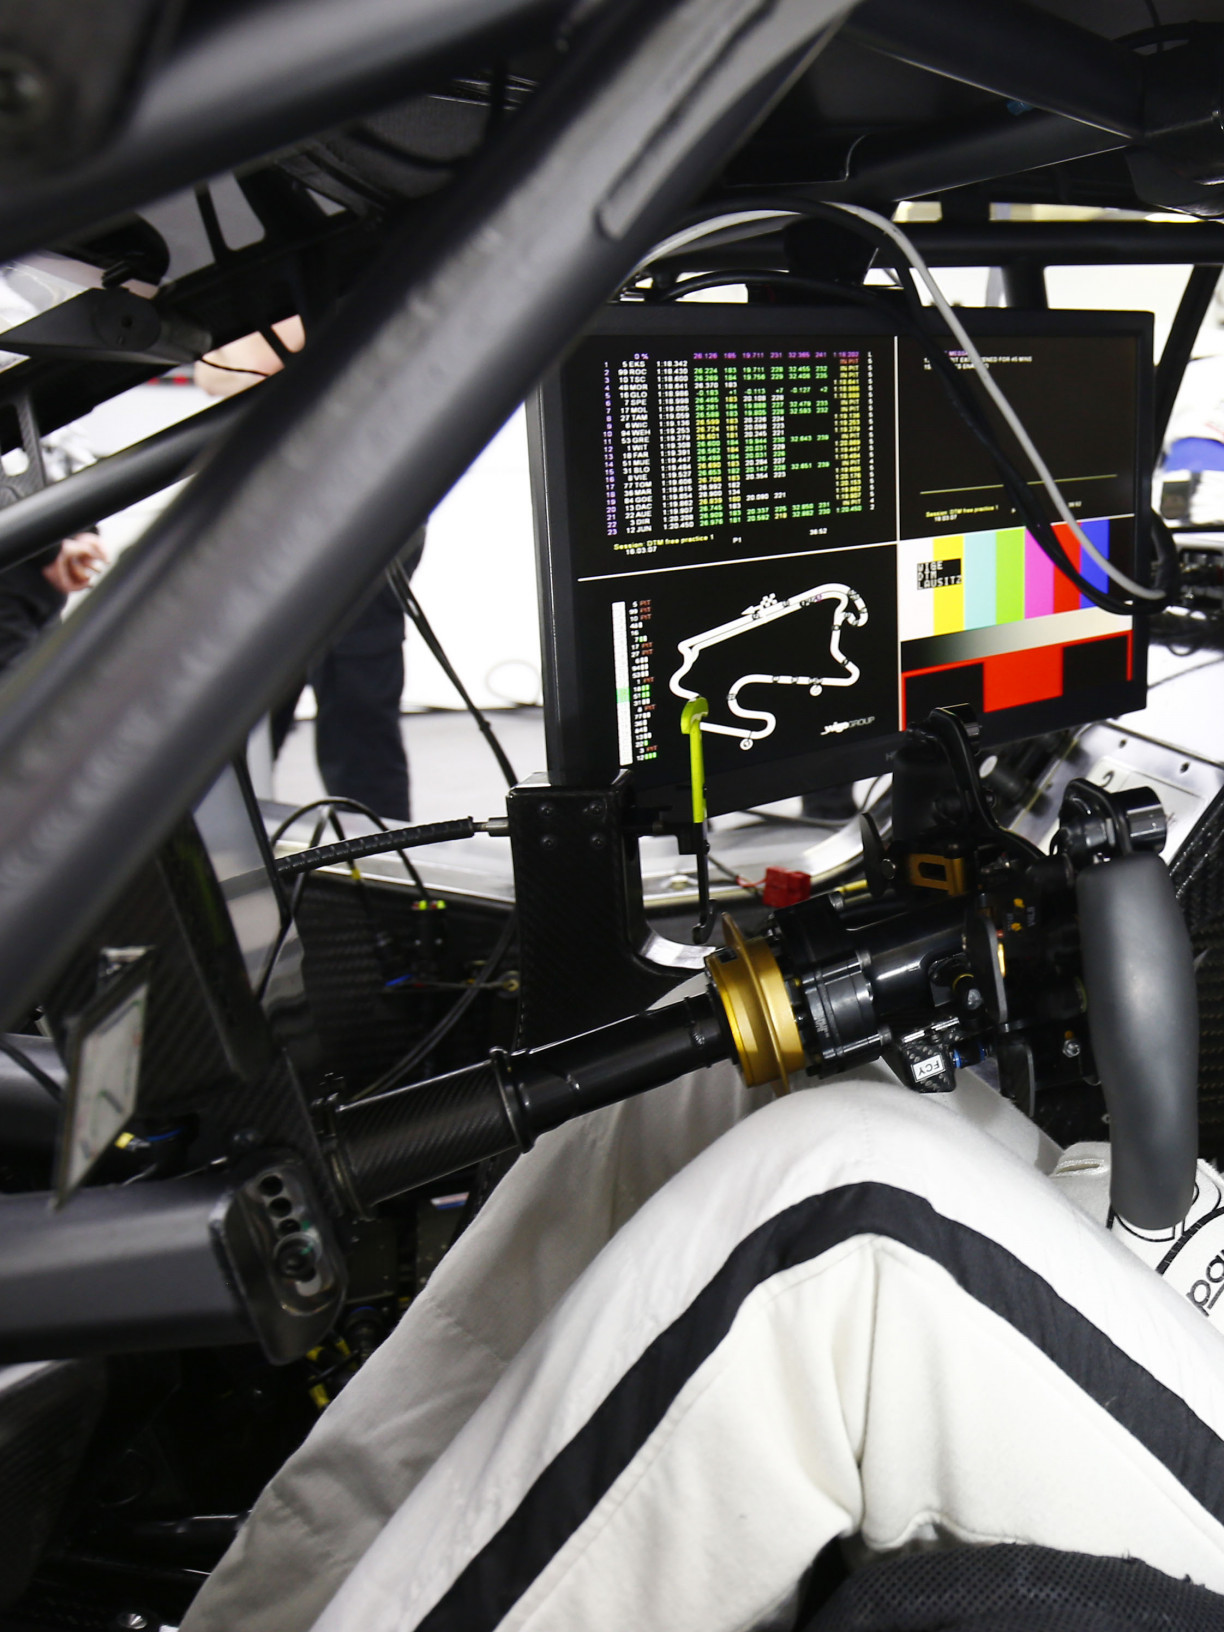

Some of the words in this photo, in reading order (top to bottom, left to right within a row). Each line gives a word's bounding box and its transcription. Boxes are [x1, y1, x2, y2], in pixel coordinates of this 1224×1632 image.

[628, 360, 646, 368] EKS
[631, 421, 648, 429] WIC
[632, 436, 650, 444] GRE
[605, 468, 615, 476] 15
[633, 466, 650, 474] BLO
[633, 473, 648, 481] VIE
[634, 481, 652, 489] TOM
[633, 488, 652, 496] MAR
[606, 498, 616, 506] 19
[635, 495, 653, 503] GOE
[635, 503, 652, 511] DAC
[606, 513, 616, 521] 21
[635, 510, 652, 518] AUE
[636, 518, 651, 526] DIR
[607, 528, 618, 536] 23
[636, 525, 652, 533] JUN
[646, 539, 664, 547] DTM
[732, 536, 742, 544] P1
[917, 574, 962, 591] LAUSITZ
[918, 1059, 940, 1076] FCY
